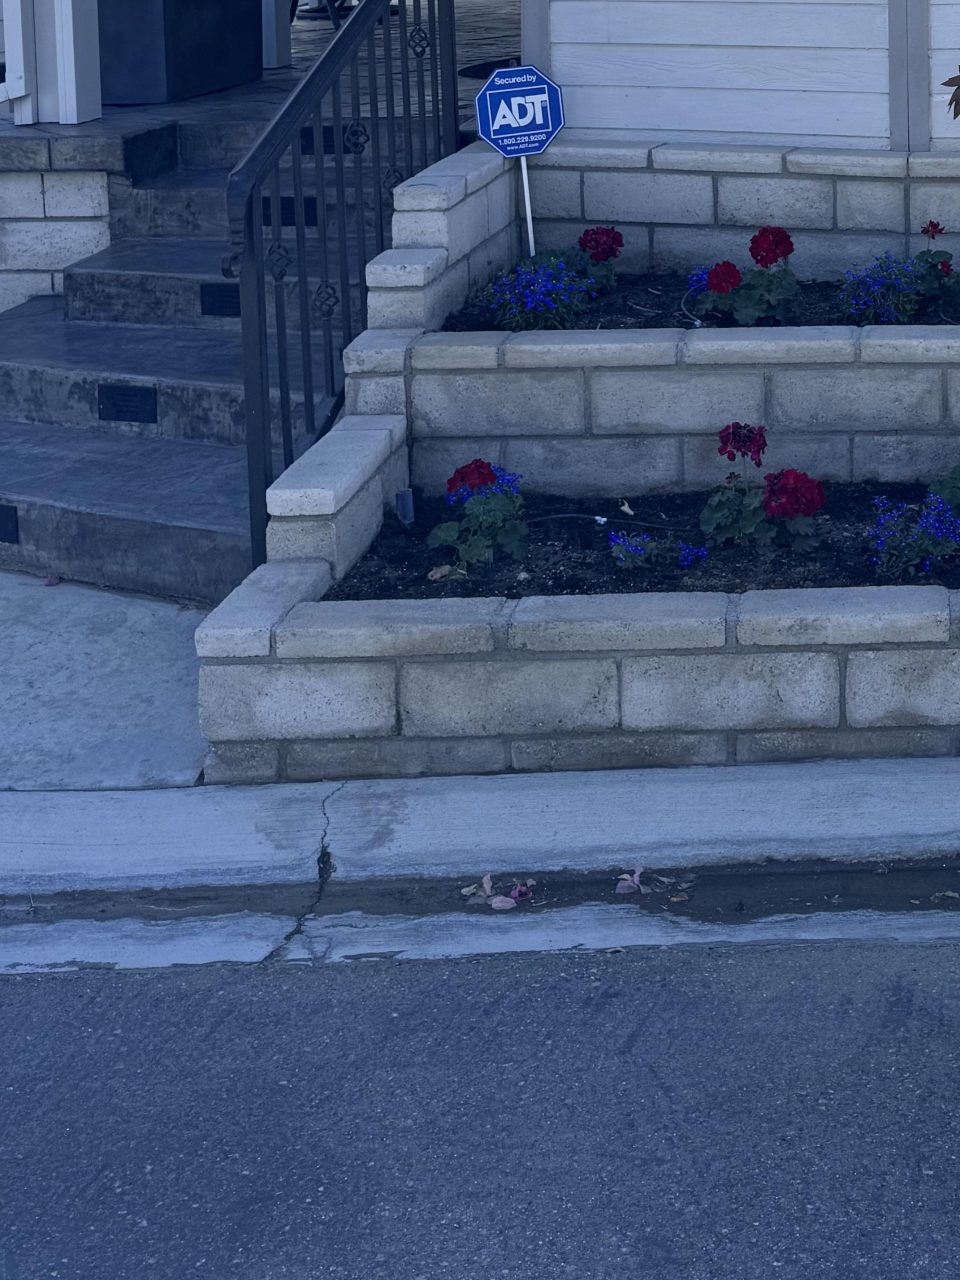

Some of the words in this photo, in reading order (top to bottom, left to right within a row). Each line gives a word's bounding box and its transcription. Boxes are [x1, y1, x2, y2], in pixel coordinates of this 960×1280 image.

[494, 75, 526, 85] Secured
[526, 74, 537, 83] by
[492, 93, 549, 130] ADT
